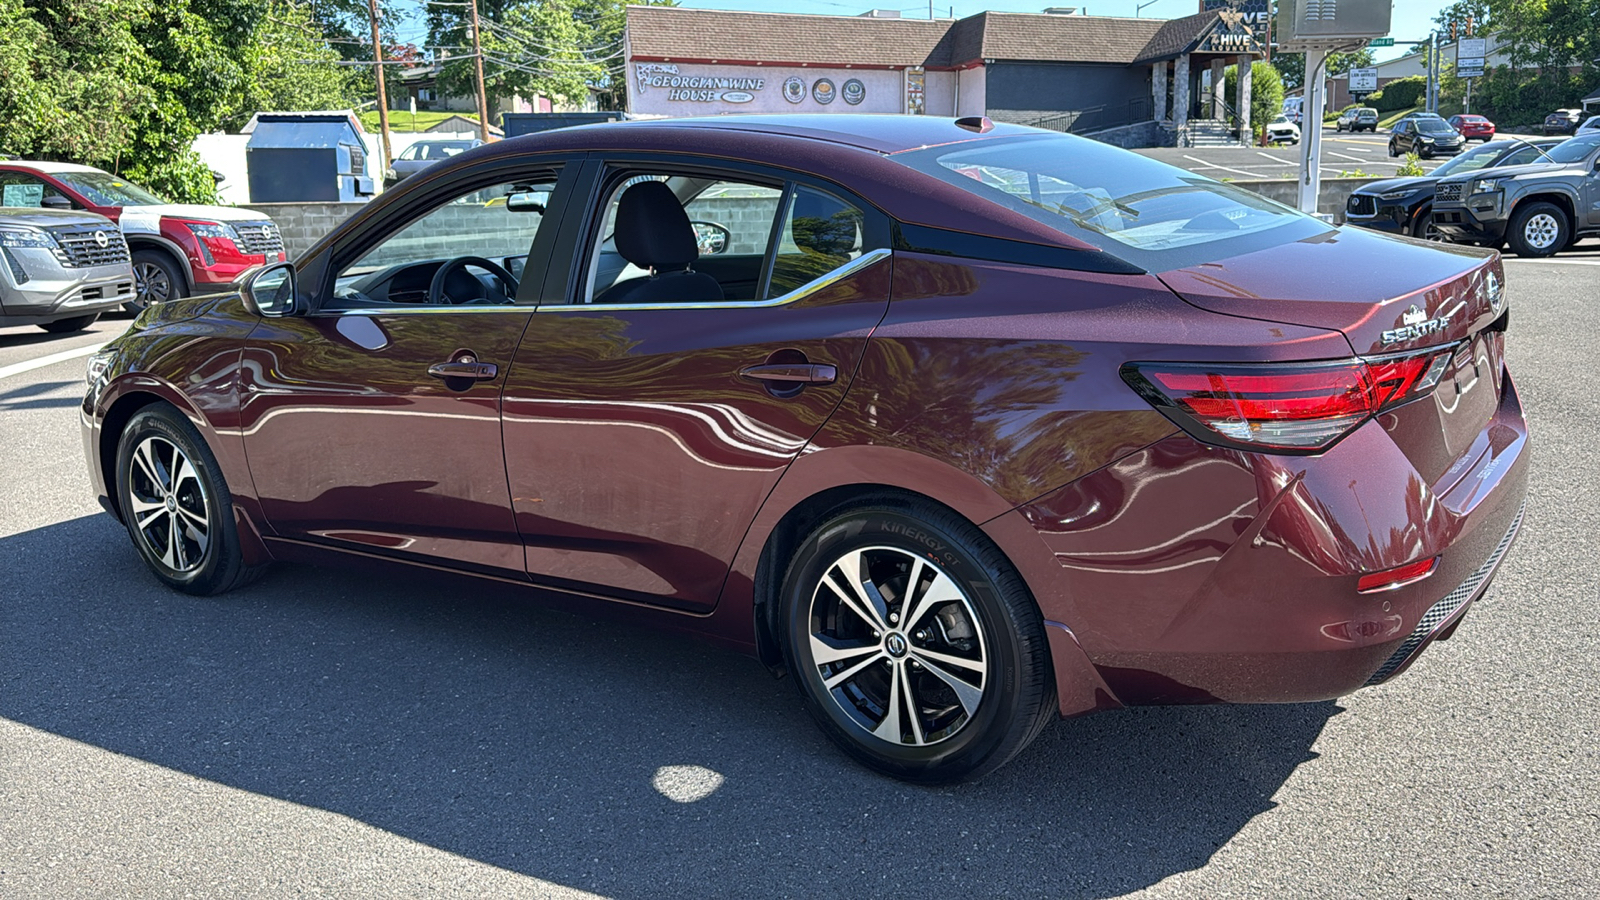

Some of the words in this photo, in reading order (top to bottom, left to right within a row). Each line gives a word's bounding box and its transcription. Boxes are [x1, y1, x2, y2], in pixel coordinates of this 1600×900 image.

[1243, 11, 1268, 24] VE
[1220, 34, 1251, 46] HIVE
[651, 76, 724, 89] GEORGIAN
[727, 78, 765, 90] WINE
[667, 89, 715, 102] HOUSE
[1380, 316, 1450, 346] SENTRA
[943, 551, 962, 566] GT
